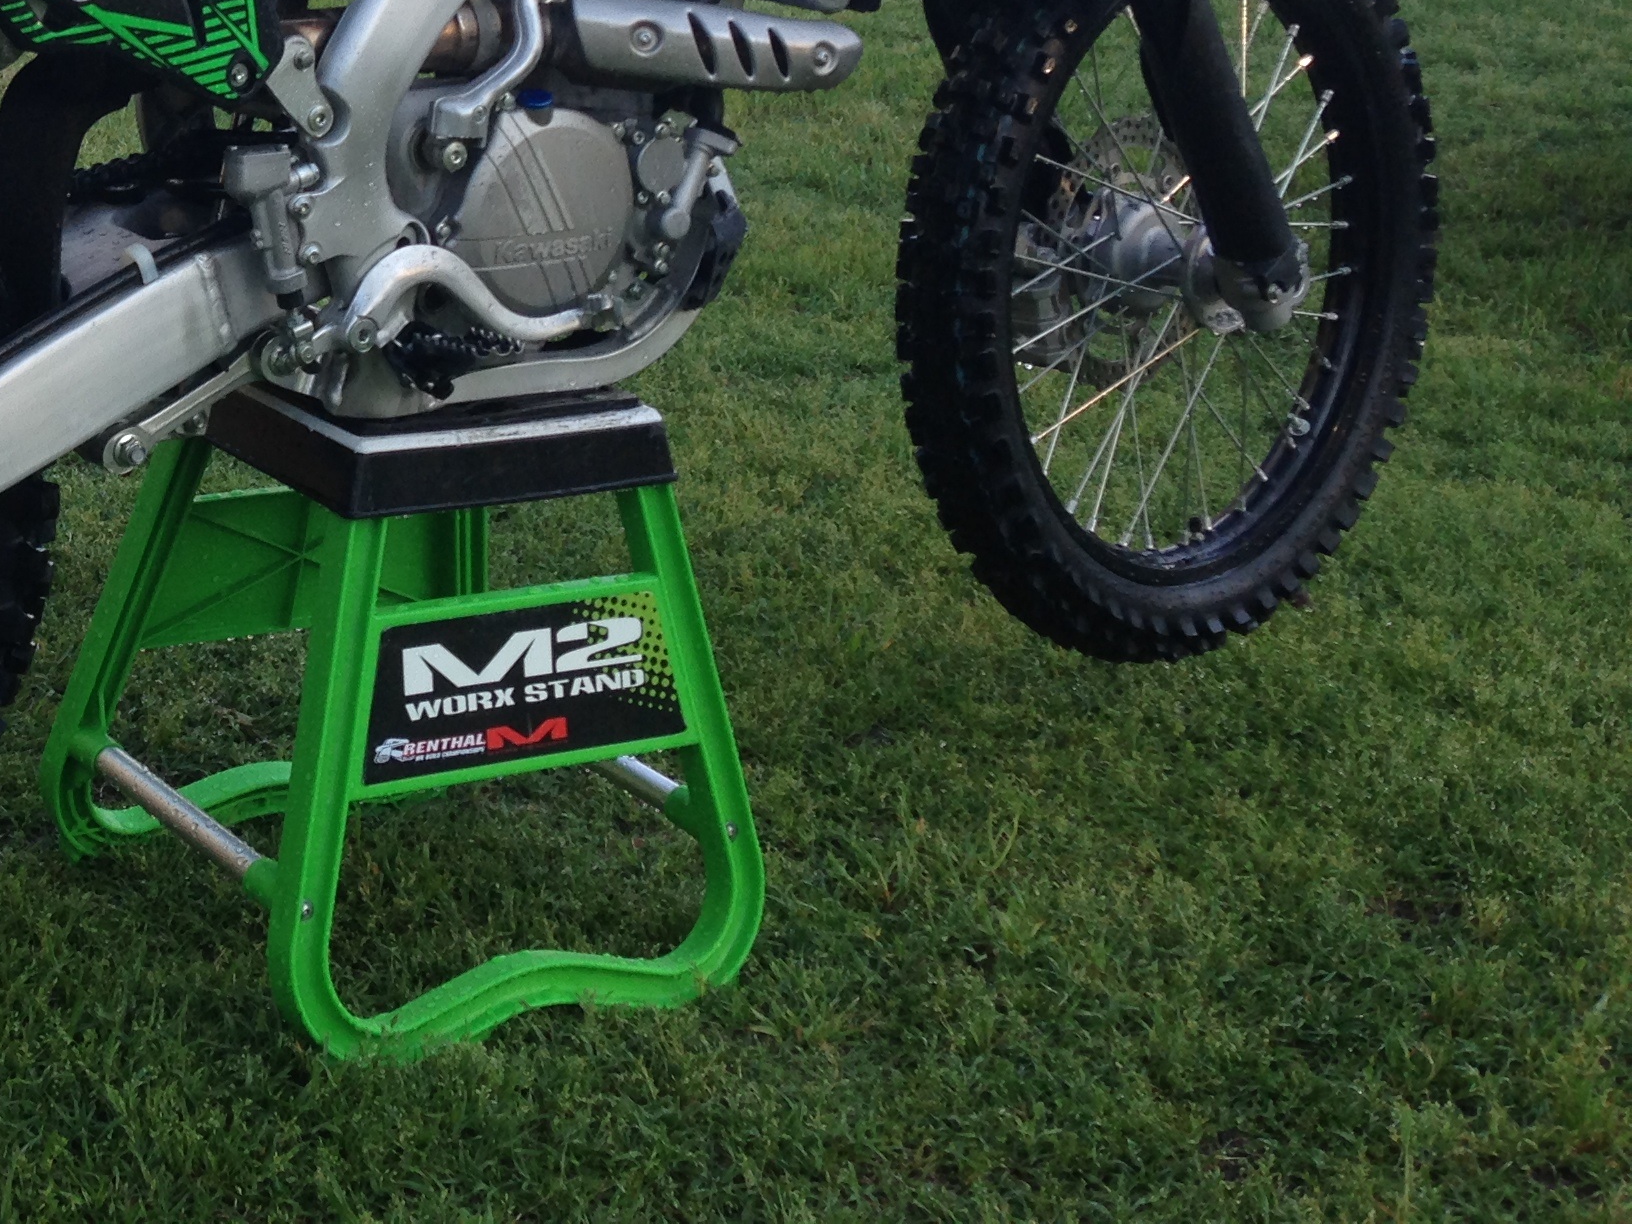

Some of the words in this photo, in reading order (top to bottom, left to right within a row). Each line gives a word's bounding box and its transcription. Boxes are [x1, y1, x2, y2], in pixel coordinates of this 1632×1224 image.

[494, 226, 614, 265] Kawasaki
[402, 616, 643, 697] M2
[404, 683, 516, 722] WORX
[524, 669, 645, 704] STAND
[402, 733, 486, 756] RENTHAL
